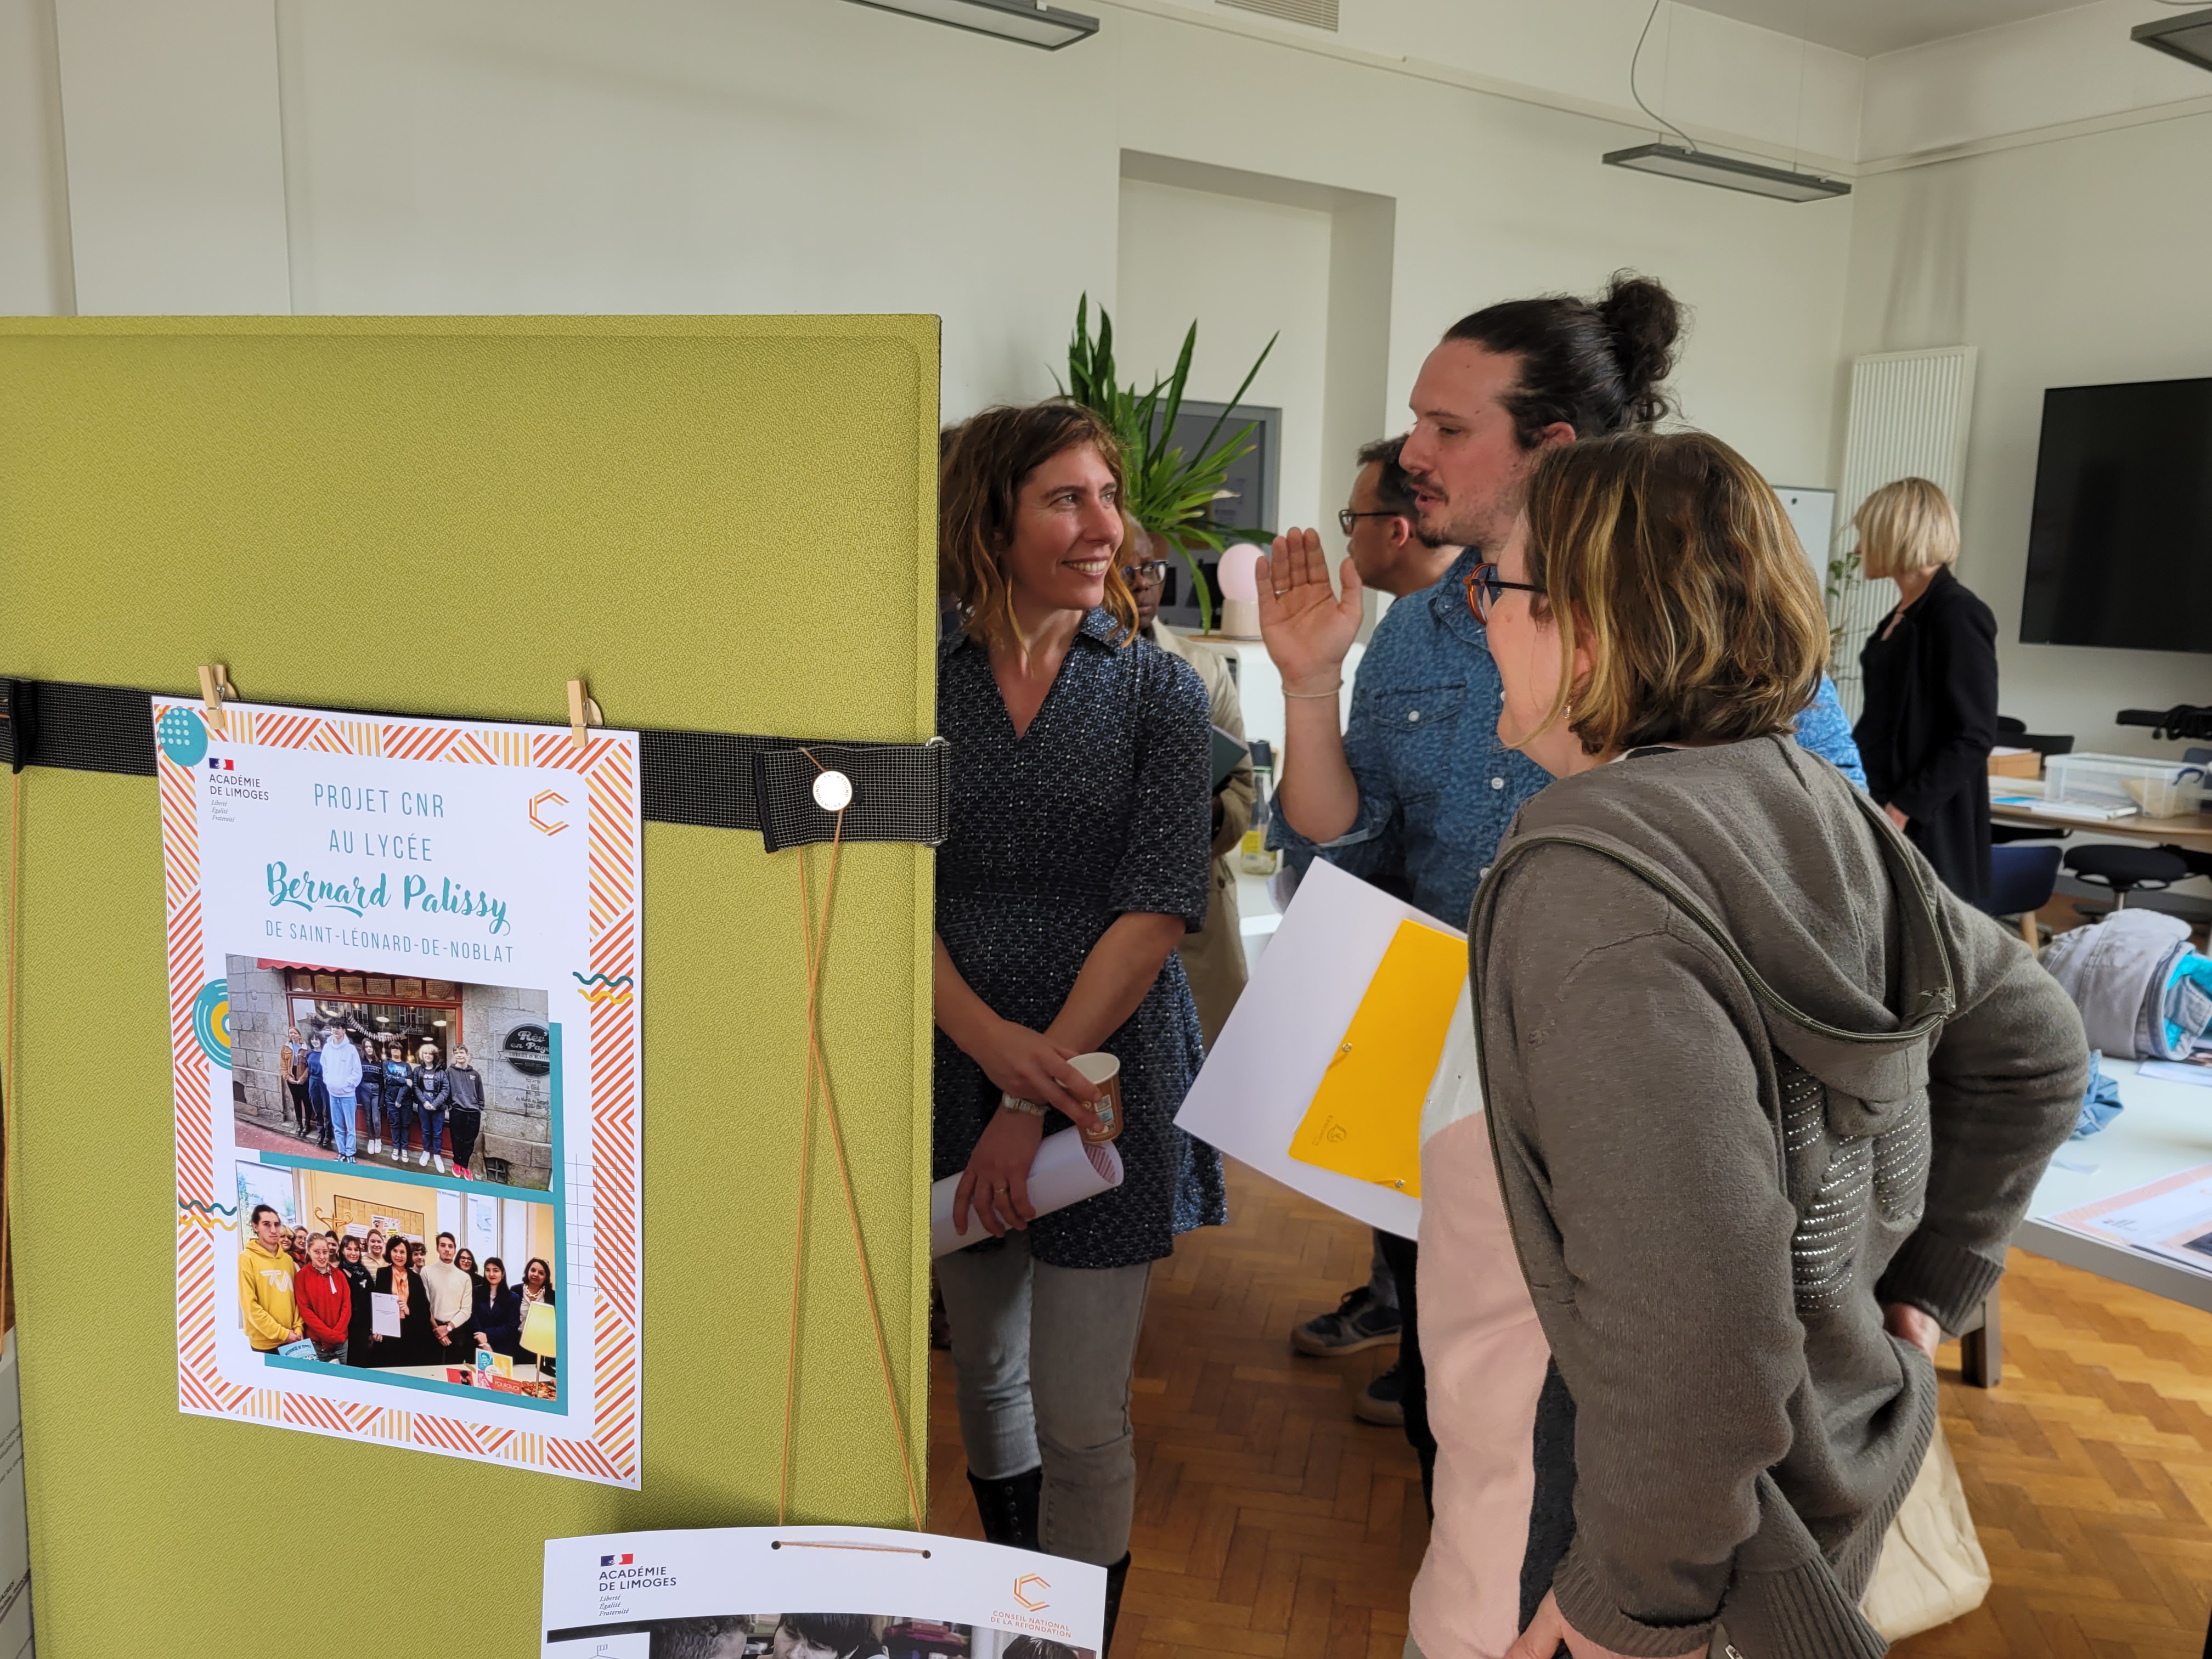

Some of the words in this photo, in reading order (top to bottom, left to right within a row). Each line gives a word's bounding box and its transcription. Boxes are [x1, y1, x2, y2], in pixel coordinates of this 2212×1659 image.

[209, 774, 261, 788] ACADÉMIE
[210, 786, 223, 795] DE
[225, 787, 269, 801] LIMOGES
[314, 783, 389, 813] PROJET
[402, 792, 444, 817] CNR
[329, 830, 353, 854] AU
[365, 833, 432, 861] LYCÉE
[267, 861, 392, 918] Bernard
[404, 874, 511, 936] Palissy
[266, 920, 283, 937] DE
[290, 923, 514, 963] SAINT-LÉONARD-DE-NOBLAT
[599, 1566, 667, 1581] ACADÉMIE
[599, 1582, 616, 1592] DE
[620, 1577, 676, 1590] LIMOGES
[599, 1601, 621, 1610] Égalité
[599, 1608, 630, 1616] Fraternité
[993, 1611, 1026, 1622] CONSEIL
[1029, 1617, 1070, 1631] NATIONAL
[1015, 1621, 1071, 1638] REFONDATION
